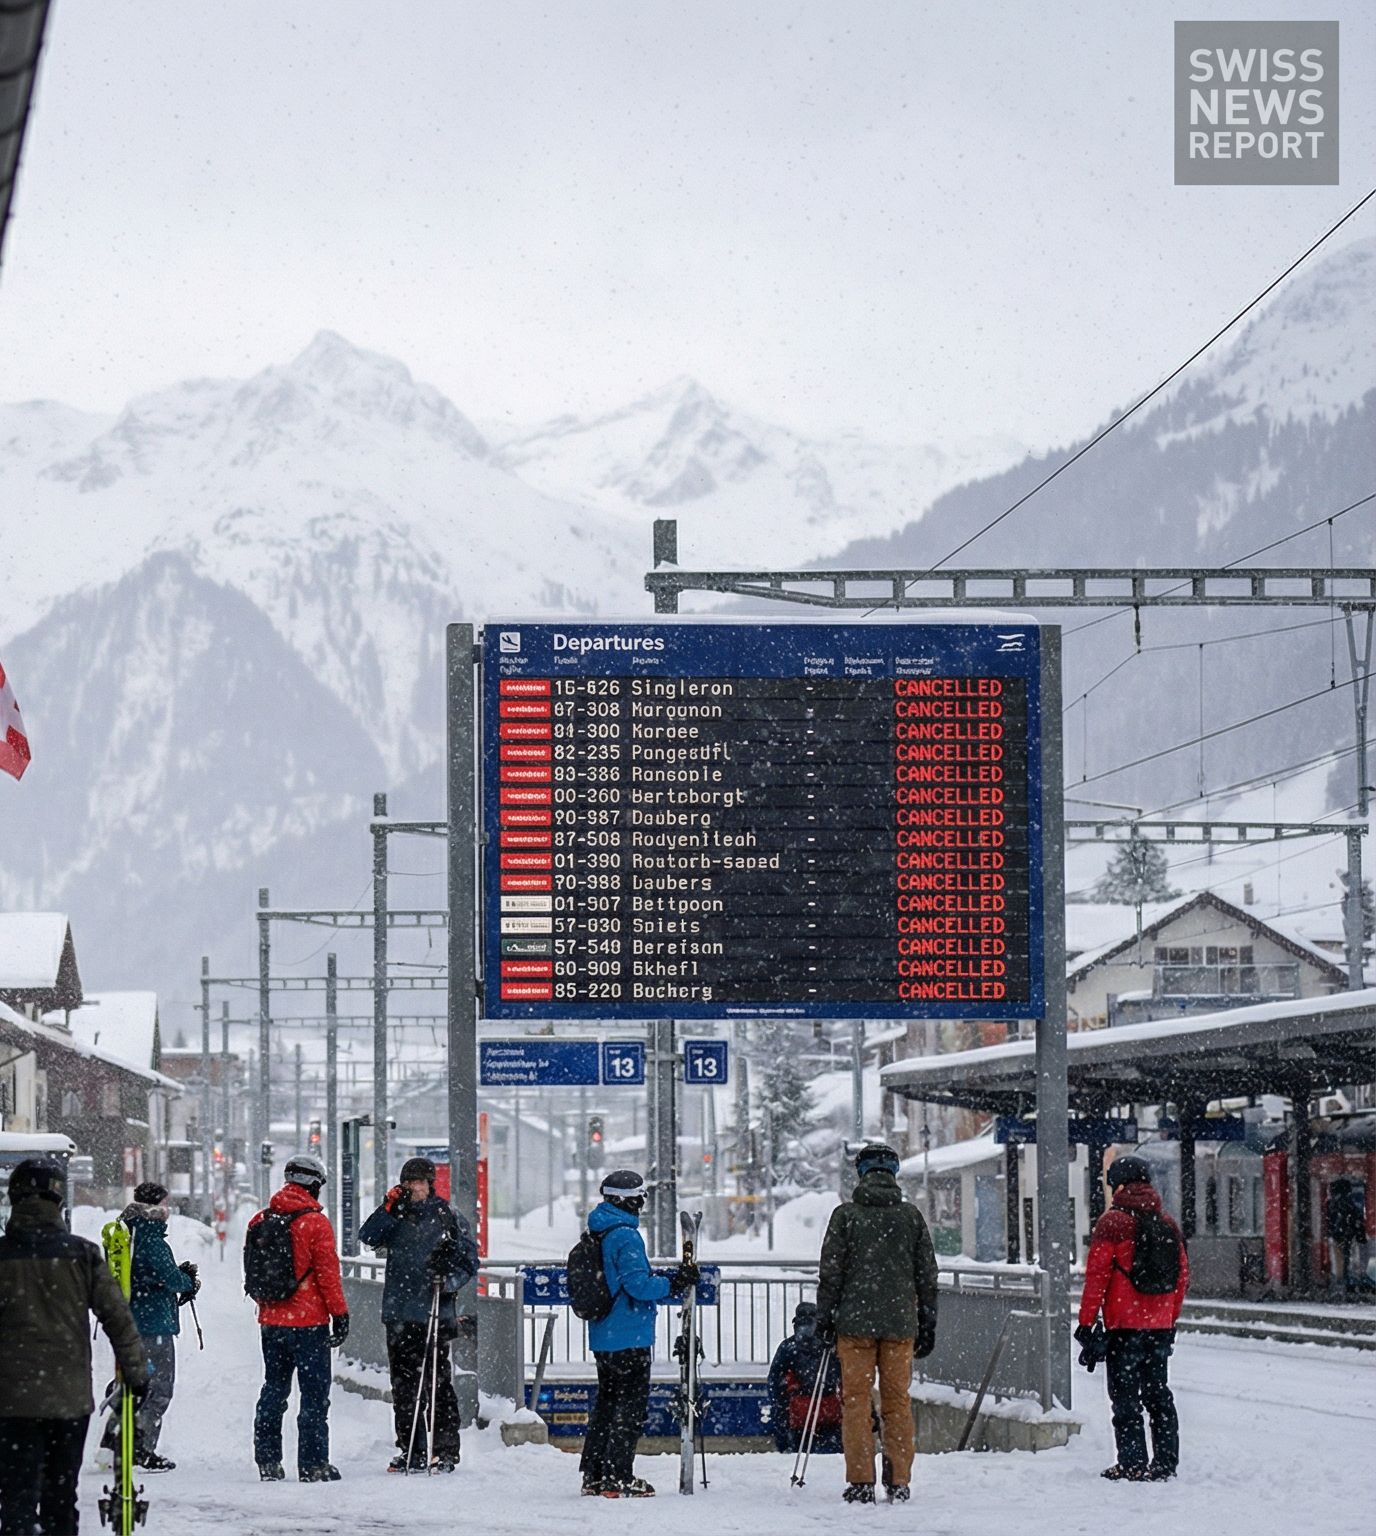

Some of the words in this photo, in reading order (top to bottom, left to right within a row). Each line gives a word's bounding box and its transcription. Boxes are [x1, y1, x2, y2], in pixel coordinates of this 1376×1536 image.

[553, 633, 665, 656] Departures
[895, 679, 1002, 696] CANCELLED
[896, 701, 1002, 717] CANCELLED
[896, 723, 1003, 739] CANCELLED
[896, 744, 1003, 760] CANCELLED
[896, 765, 1002, 782] CANCELLED
[896, 788, 1004, 804] CANCELLED
[897, 809, 1004, 826] CANCELLED
[897, 830, 1004, 847] CANCELLED
[898, 852, 1004, 869] CANCELLED
[898, 874, 1004, 890] CANCELLED
[898, 895, 1004, 912] CANCELLED
[898, 917, 1004, 933] CANCELLED
[898, 939, 1004, 955] CANCELLED
[898, 960, 1004, 976] CANCELLED
[899, 982, 1005, 999] CANCELLED
[611, 1057, 635, 1078] 13
[693, 1057, 718, 1078] 13
